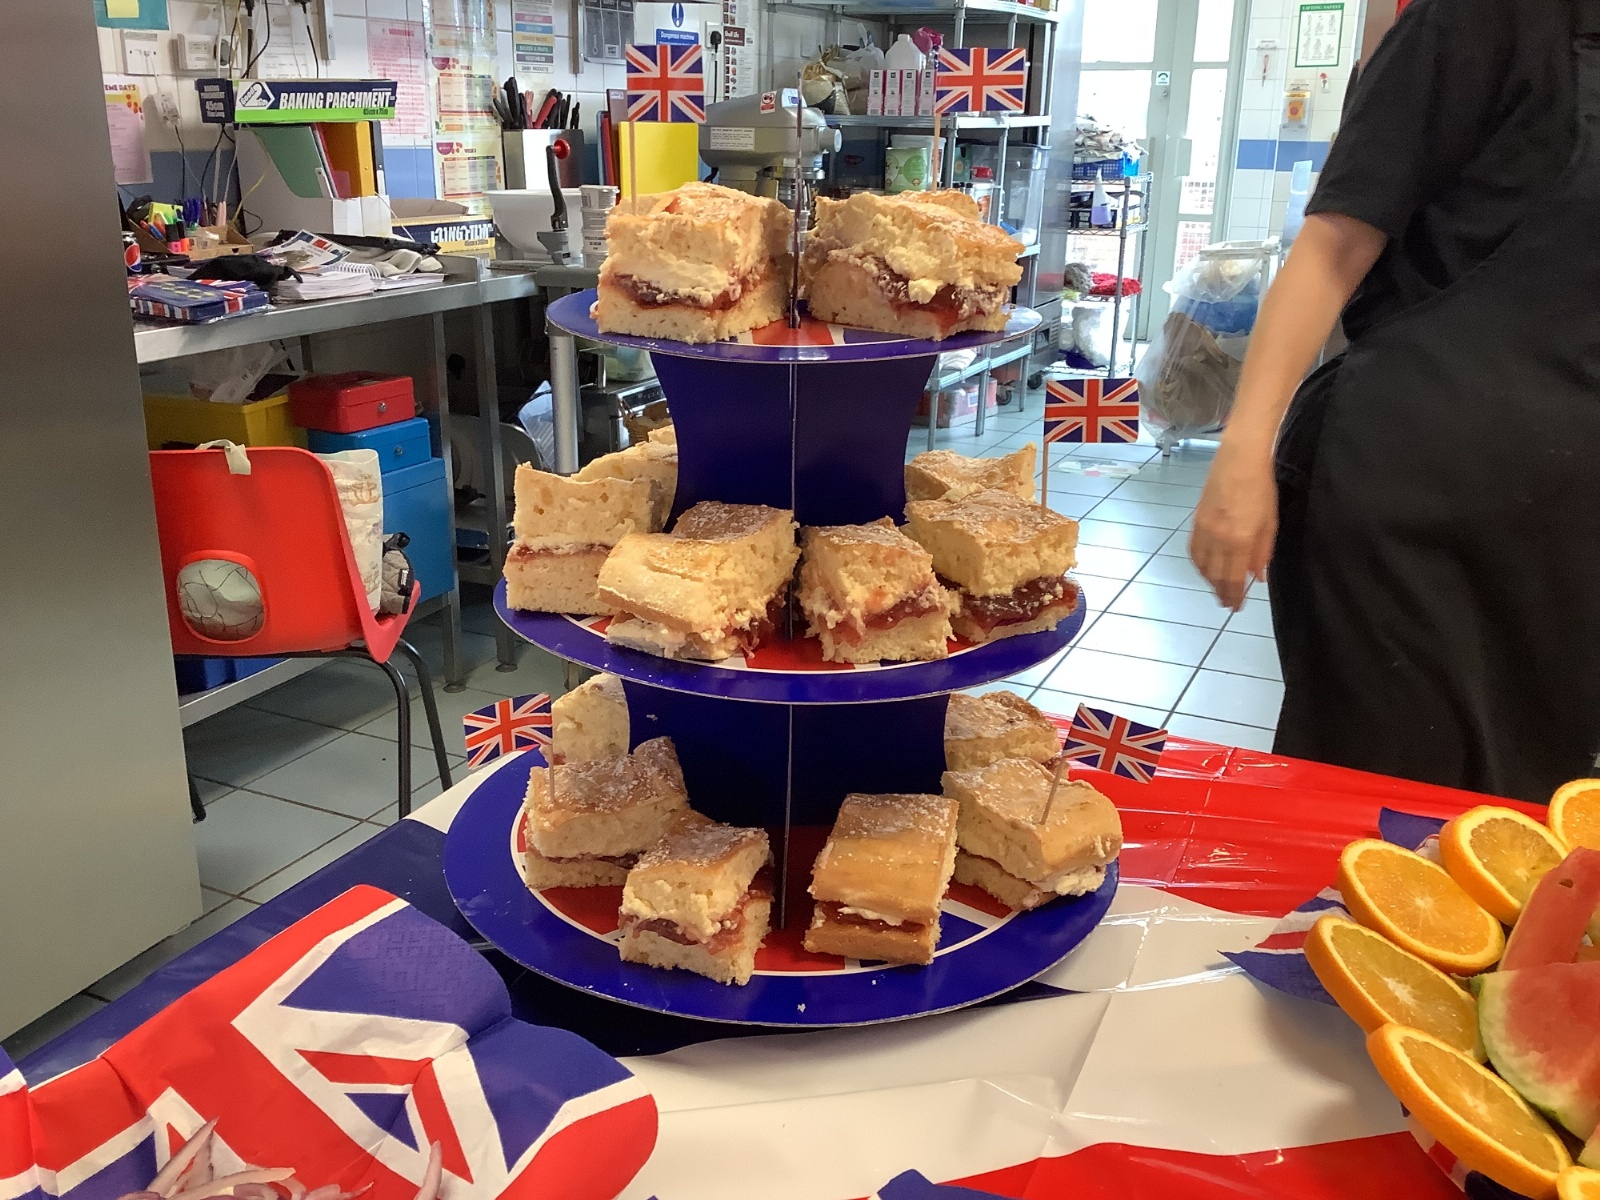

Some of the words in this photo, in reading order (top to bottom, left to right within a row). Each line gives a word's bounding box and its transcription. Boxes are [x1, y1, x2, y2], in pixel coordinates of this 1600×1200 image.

[661, 31, 680, 39] Dangerous
[280, 92, 324, 109] BAKING
[325, 92, 391, 108] PARCHMENT
